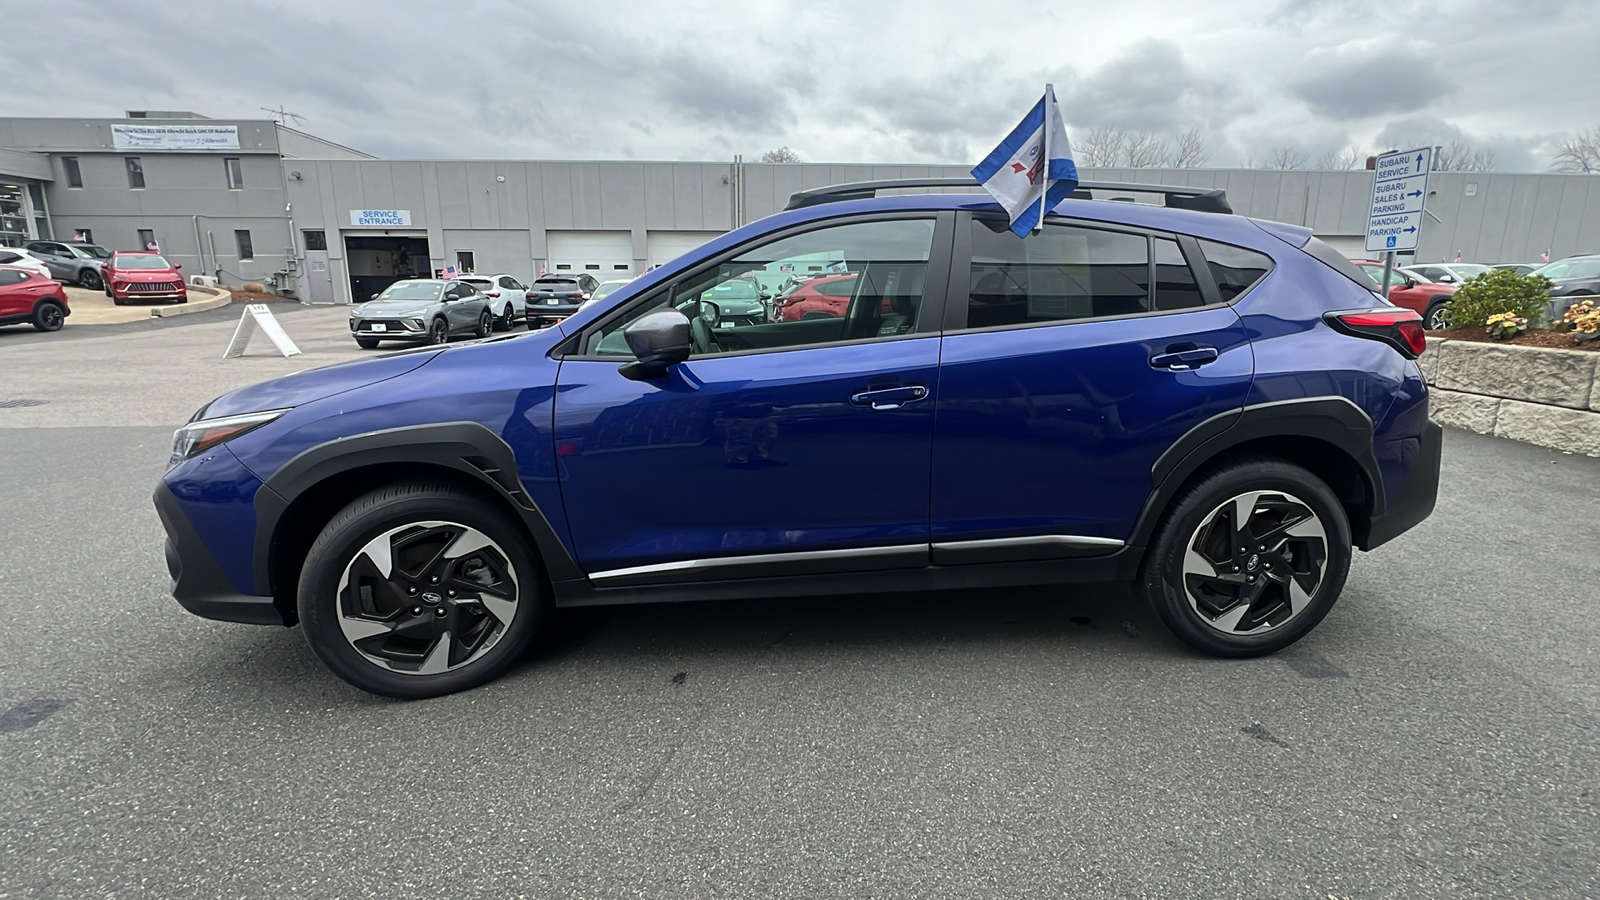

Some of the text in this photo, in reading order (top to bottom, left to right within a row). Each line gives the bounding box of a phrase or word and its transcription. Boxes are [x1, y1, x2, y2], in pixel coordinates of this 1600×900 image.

[1380, 156, 1410, 168] SUBARU
[1378, 166, 1409, 179] SERVICE
[1376, 182, 1406, 194] SUBARU
[1374, 194, 1398, 204] SALES
[1373, 203, 1405, 214] PARKING
[1371, 216, 1409, 227] HANDICAP
[1370, 227, 1402, 236] PARKING
